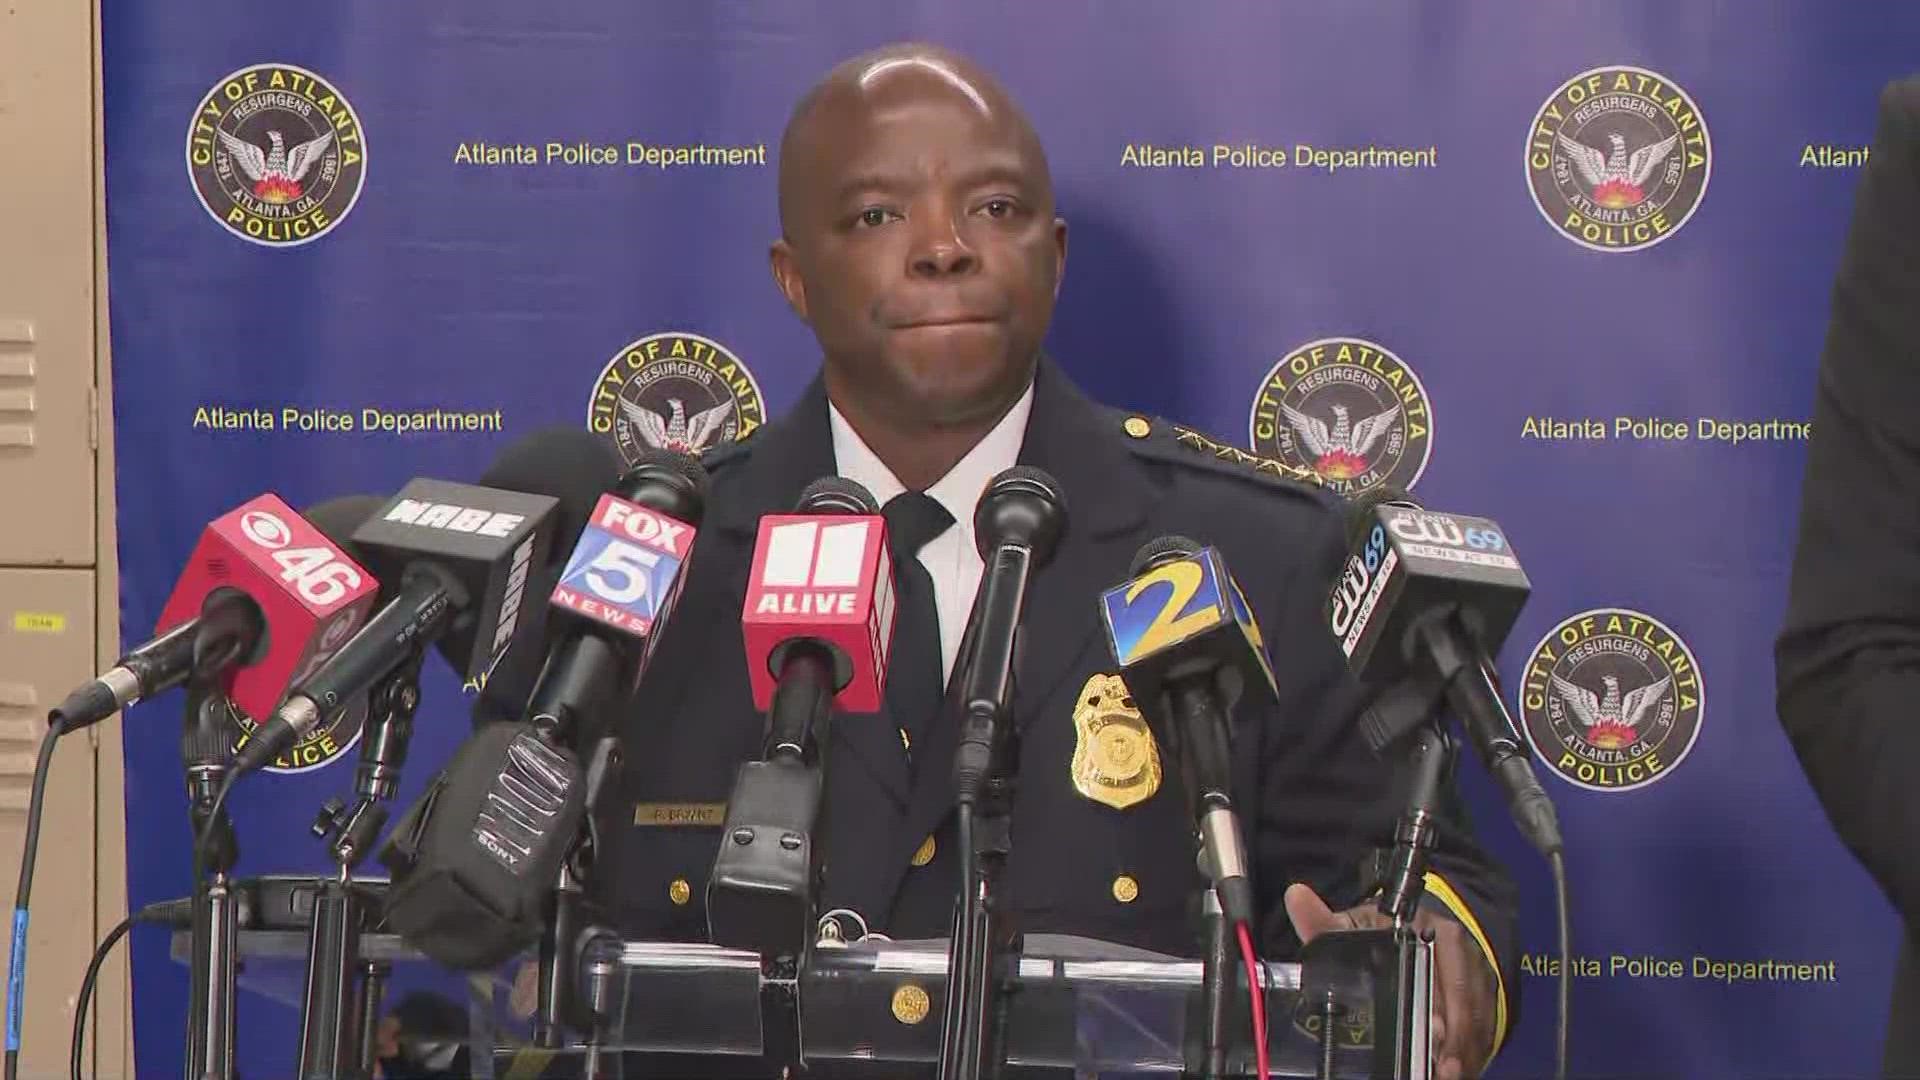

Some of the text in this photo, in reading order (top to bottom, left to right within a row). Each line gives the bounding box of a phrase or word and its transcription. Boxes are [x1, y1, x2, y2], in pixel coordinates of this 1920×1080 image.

[193, 71, 360, 166] CITY OF ATLANTA
[232, 94, 312, 120] RESURGENS
[1532, 73, 1704, 170] CITY OF ATLANTA
[1574, 97, 1657, 124] RESURGENS
[454, 142, 766, 170] Atlanta Police Department
[1120, 144, 1437, 172] Atlanta Police Department
[1800, 145, 1870, 167] Atlant
[228, 208, 329, 239] POLICE
[1565, 212, 1671, 244] POLICE
[634, 361, 713, 388] RESURGENS
[1297, 368, 1380, 394] RESURGENS
[594, 339, 760, 442] CITY OF ATLANTA
[1257, 345, 1426, 440] CITY OF ATLANTA
[193, 407, 502, 435] Atlanta Police Department
[1521, 416, 1811, 444] Atlanta Police Departme
[601, 501, 685, 553] FOX
[1465, 527, 1504, 551] 69
[1365, 523, 1385, 574] 69
[271, 547, 361, 605] 46
[585, 541, 661, 604] 5
[557, 590, 647, 632] NEWS
[756, 593, 857, 614] ALIVE
[1125, 560, 1221, 667] 2
[1526, 615, 1697, 711] CITY OF ATLANTA
[1567, 638, 1650, 665] RESURGENS
[1559, 753, 1665, 785] POLICE
[479, 833, 519, 863] SONY
[1611, 956, 1683, 978] Police
[1693, 957, 1837, 984] Department
